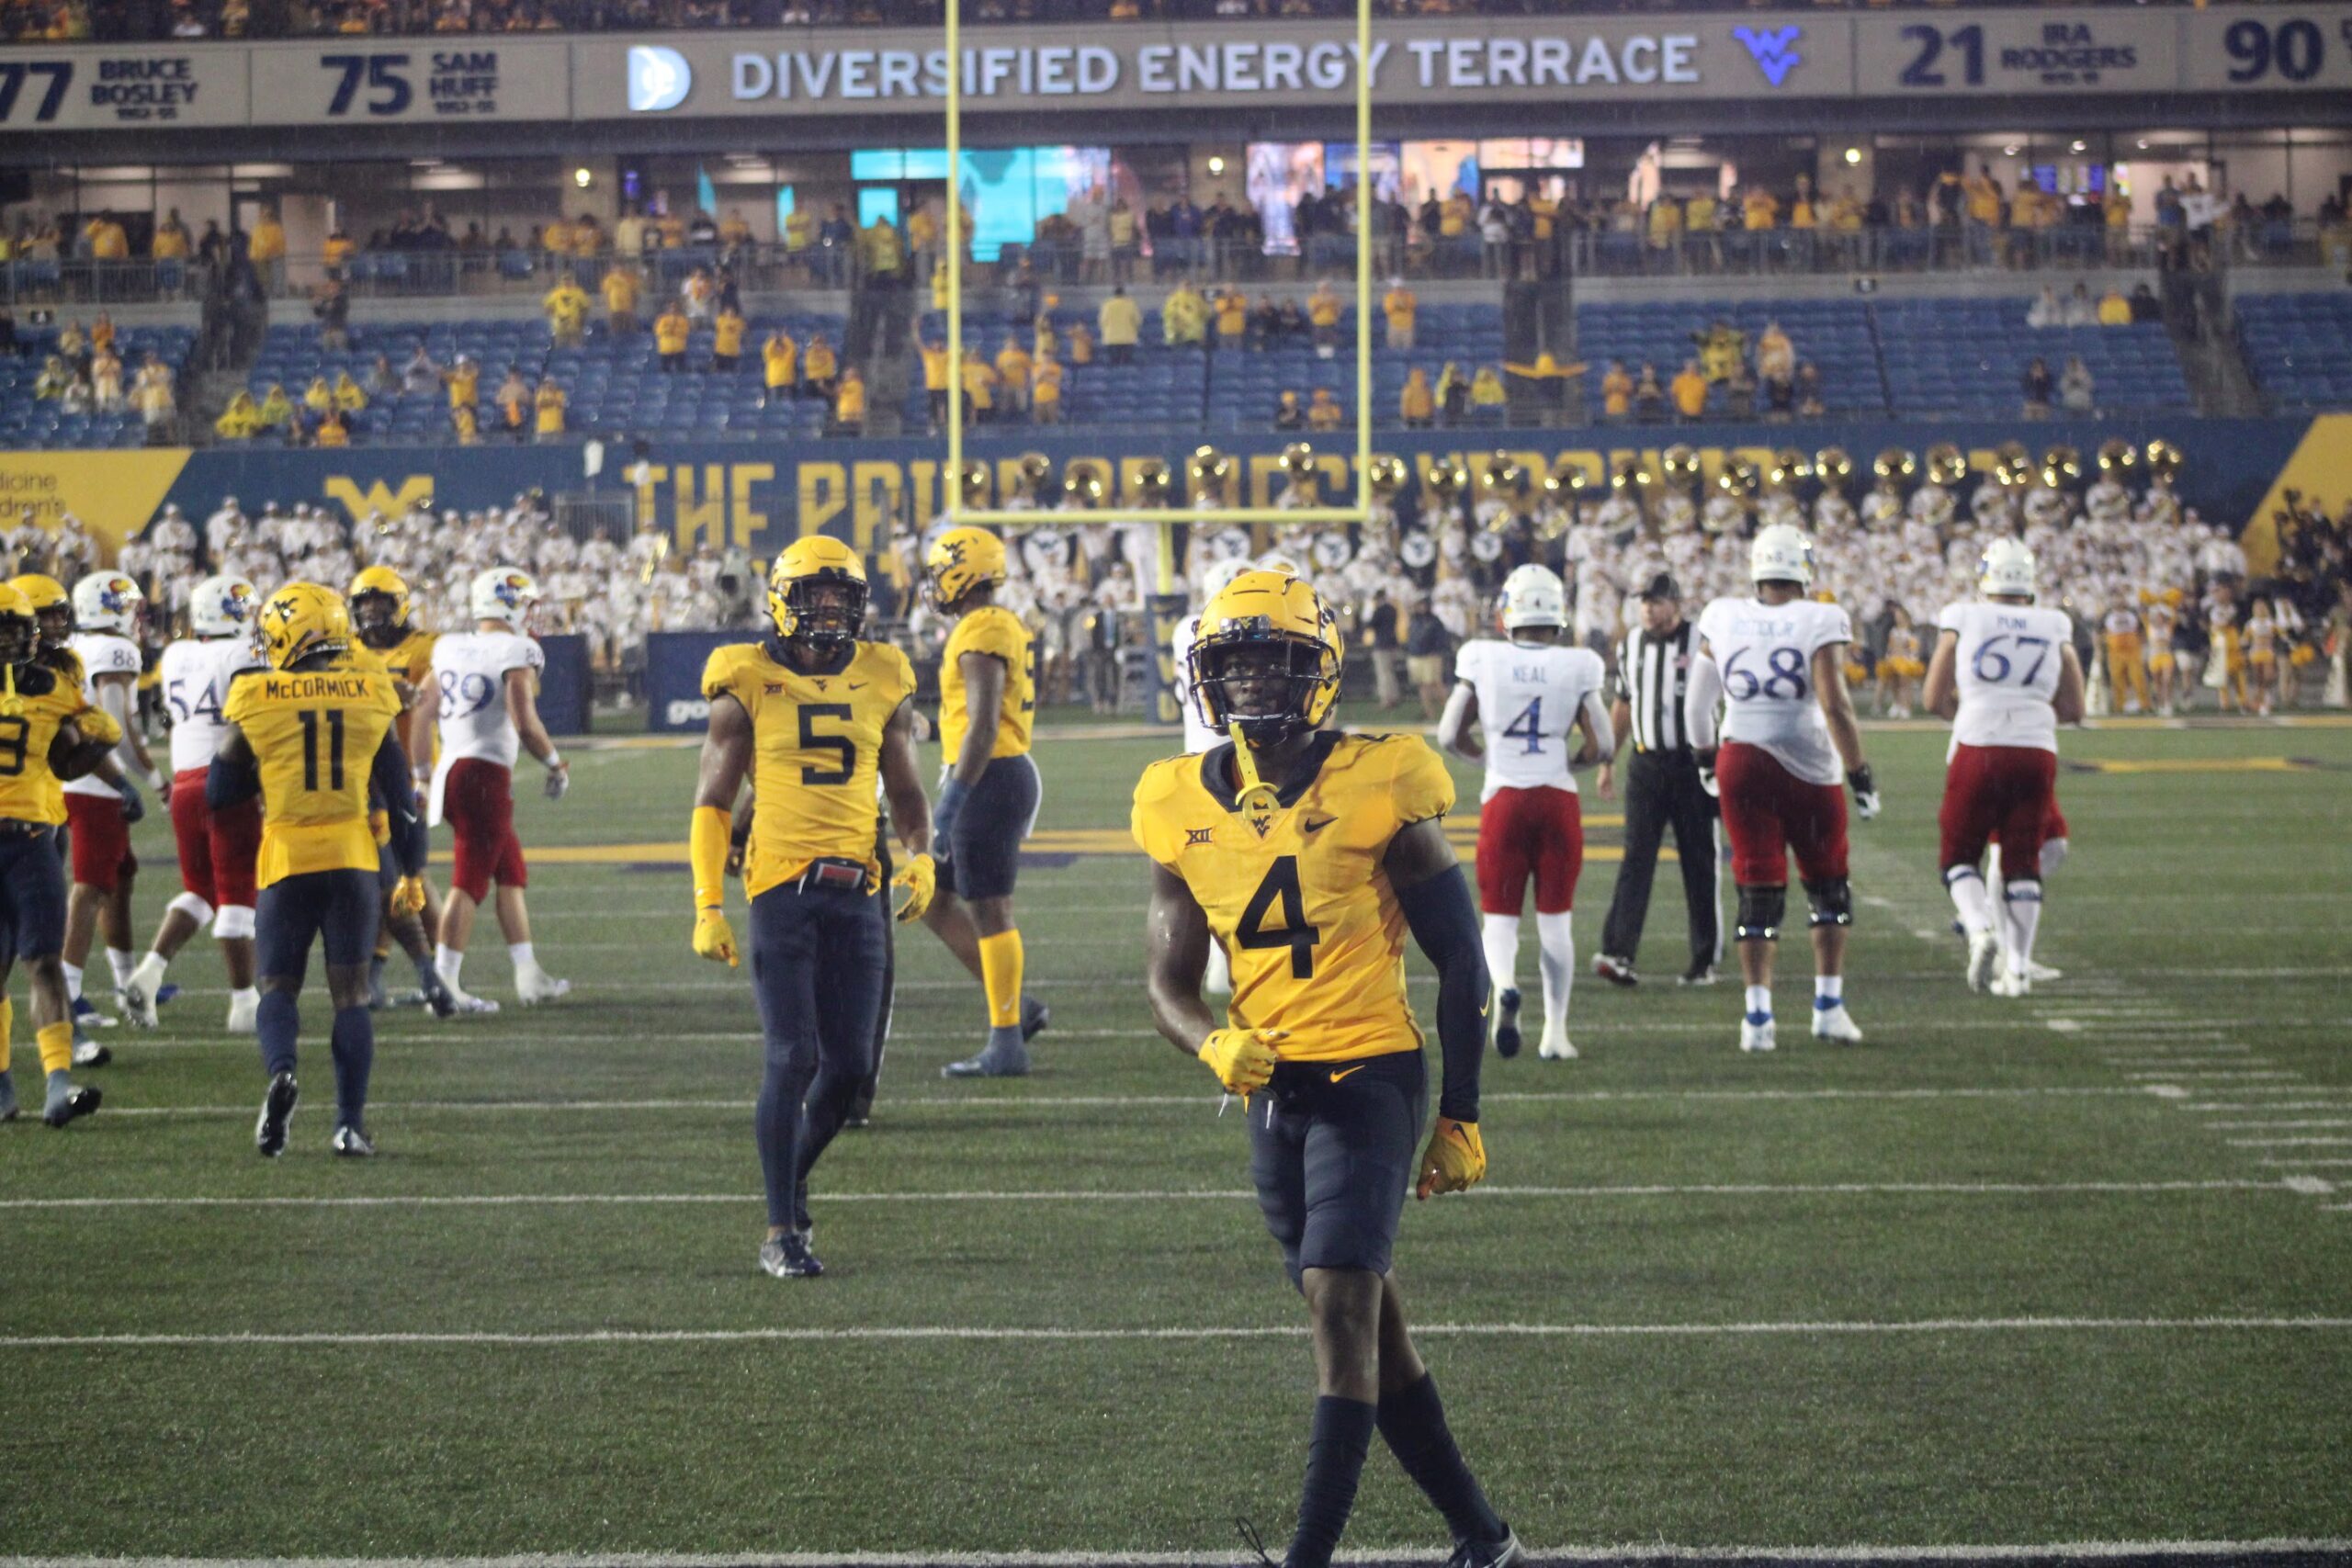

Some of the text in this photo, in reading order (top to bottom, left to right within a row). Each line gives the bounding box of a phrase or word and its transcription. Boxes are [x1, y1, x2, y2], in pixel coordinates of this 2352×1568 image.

[98, 59, 190, 81] BRUCE
[432, 51, 497, 73] SAM
[734, 34, 1701, 99] DIVERSIFIED ENERGY TERRACE
[1899, 24, 1985, 86] 21
[2224, 18, 2324, 83] 90
[91, 83, 198, 106] BOSLEY
[320, 54, 413, 116] 75
[622, 462, 775, 574] THE
[1997, 616, 2027, 630] PUNI
[1724, 645, 1807, 702] 68
[1973, 634, 2052, 687] 67
[169, 676, 230, 726] 54
[439, 670, 495, 720] 89
[299, 709, 345, 792] 11
[797, 704, 856, 785] 5
[1503, 696, 1550, 755] 4
[1235, 854, 1320, 979] 4
